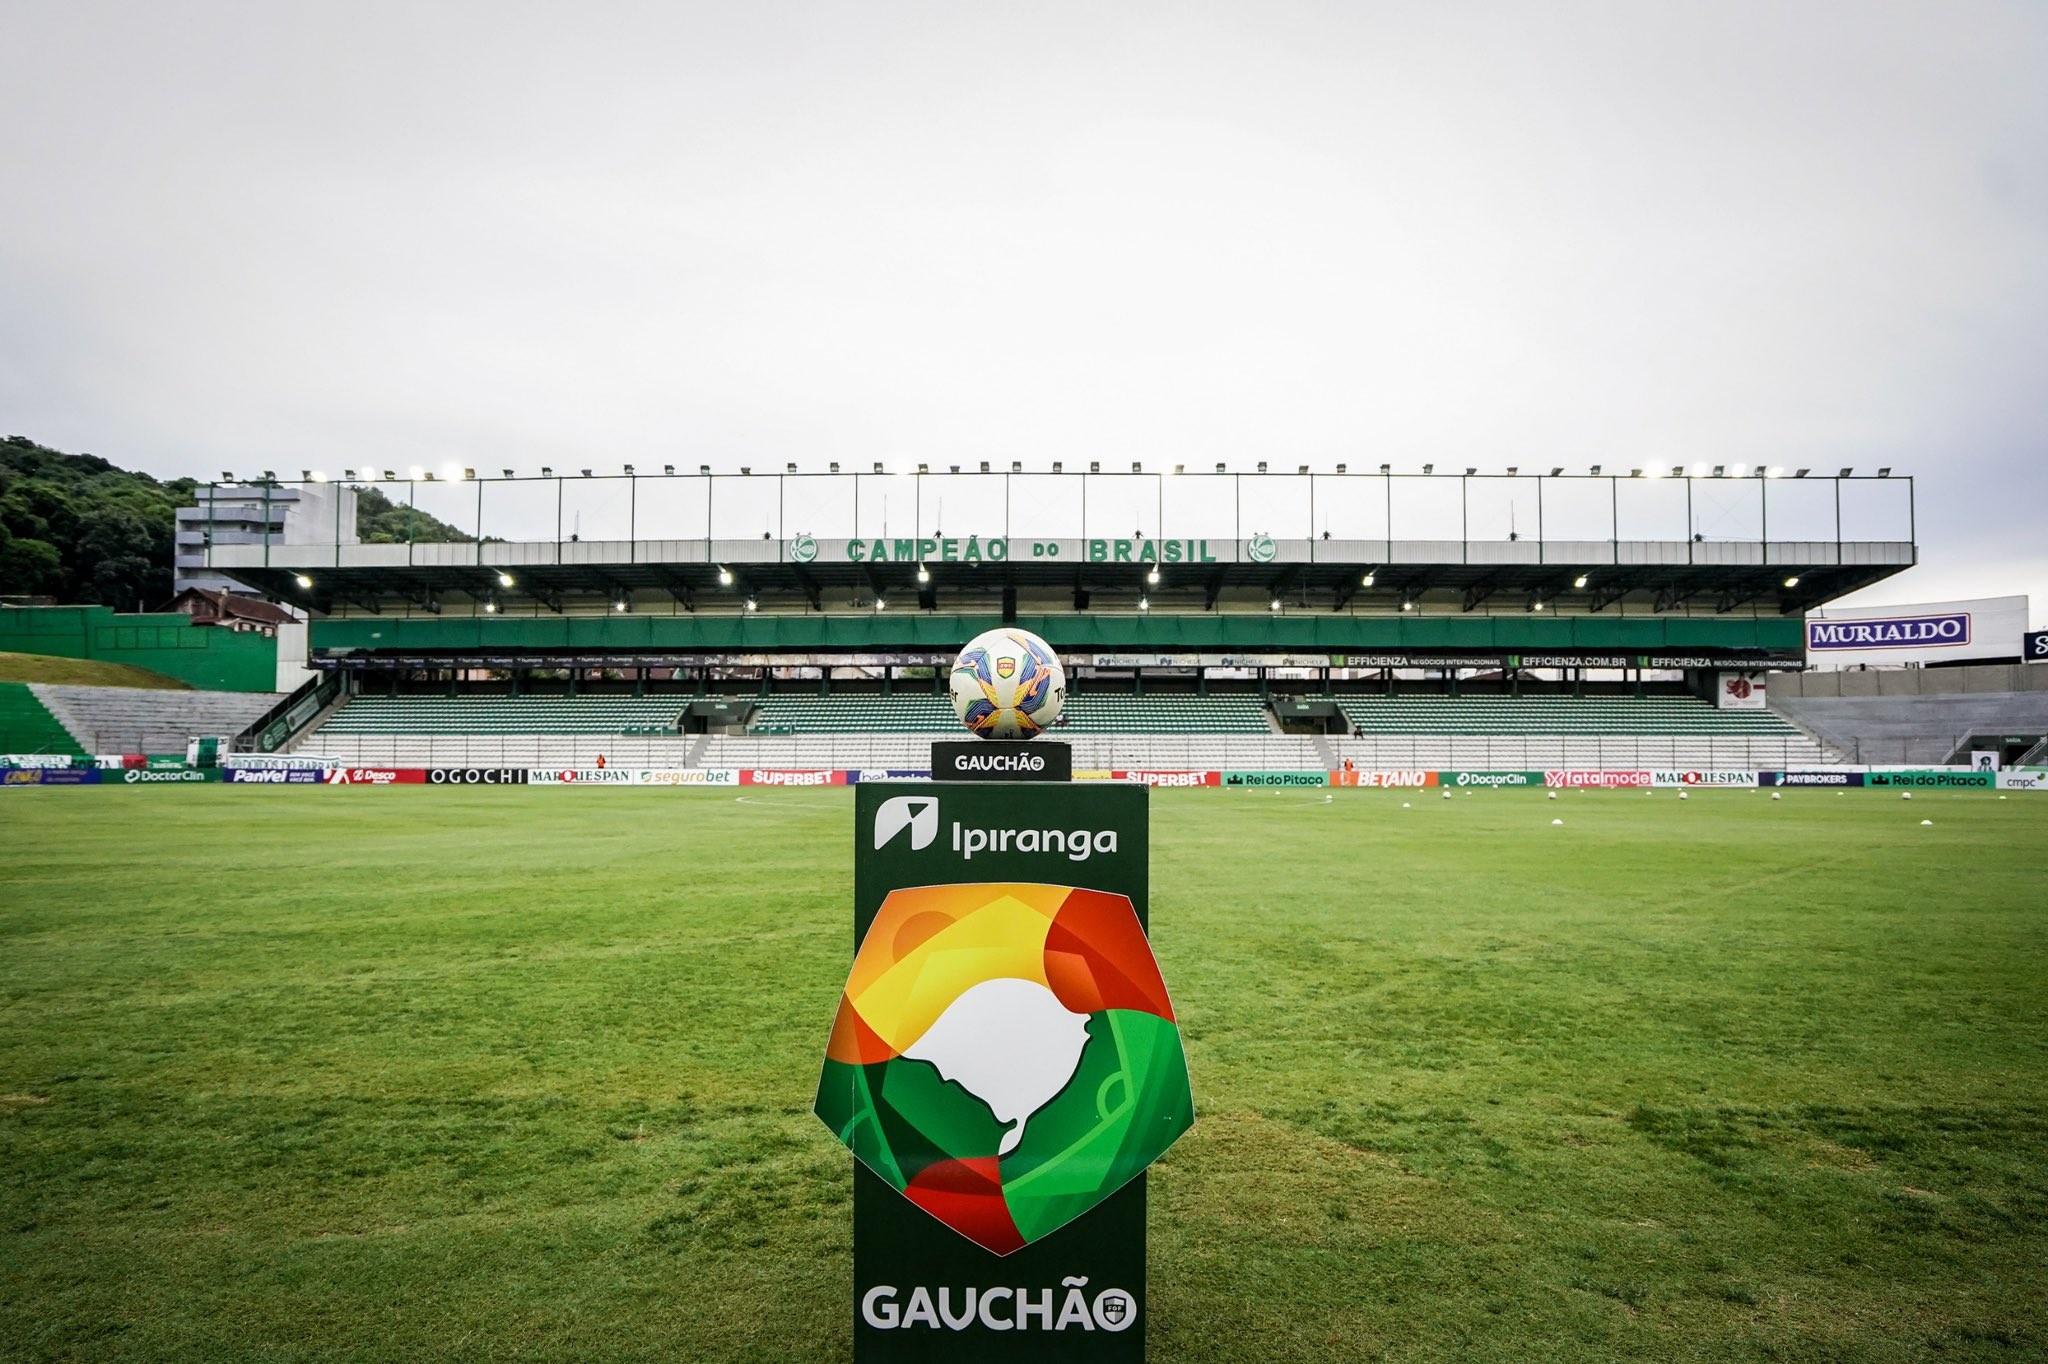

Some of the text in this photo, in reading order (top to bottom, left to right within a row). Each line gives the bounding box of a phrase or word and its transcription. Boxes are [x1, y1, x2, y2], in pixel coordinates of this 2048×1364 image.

[847, 535, 1217, 562] CAMPEÃO DO BRASIL
[1813, 619, 1961, 643] MURIALDO
[1348, 656, 1408, 666] EFFICIENZA
[1522, 656, 1627, 667] EFFICIENZA.COM.BR
[1652, 657, 1712, 667] EFFICIENZA
[955, 752, 1045, 771] GAUCHÃO
[141, 770, 205, 781] DoctorClin
[364, 770, 396, 780] Desco
[431, 769, 522, 784] OGOCHI
[532, 770, 629, 783] MARQUESPAN
[655, 769, 730, 786] segurobet
[752, 770, 833, 786] SUPERBET
[1126, 771, 1207, 787] SUPERBET
[1357, 771, 1426, 787] BETANO
[1471, 773, 1527, 784] DoctorClin
[1656, 771, 1754, 784] MARQUESPAN
[1786, 774, 1847, 784] PAYBROKERS
[2006, 779, 2036, 789] cmpc
[953, 822, 1117, 861] Ipiranga
[862, 1276, 1137, 1332] GAUCHÃO
